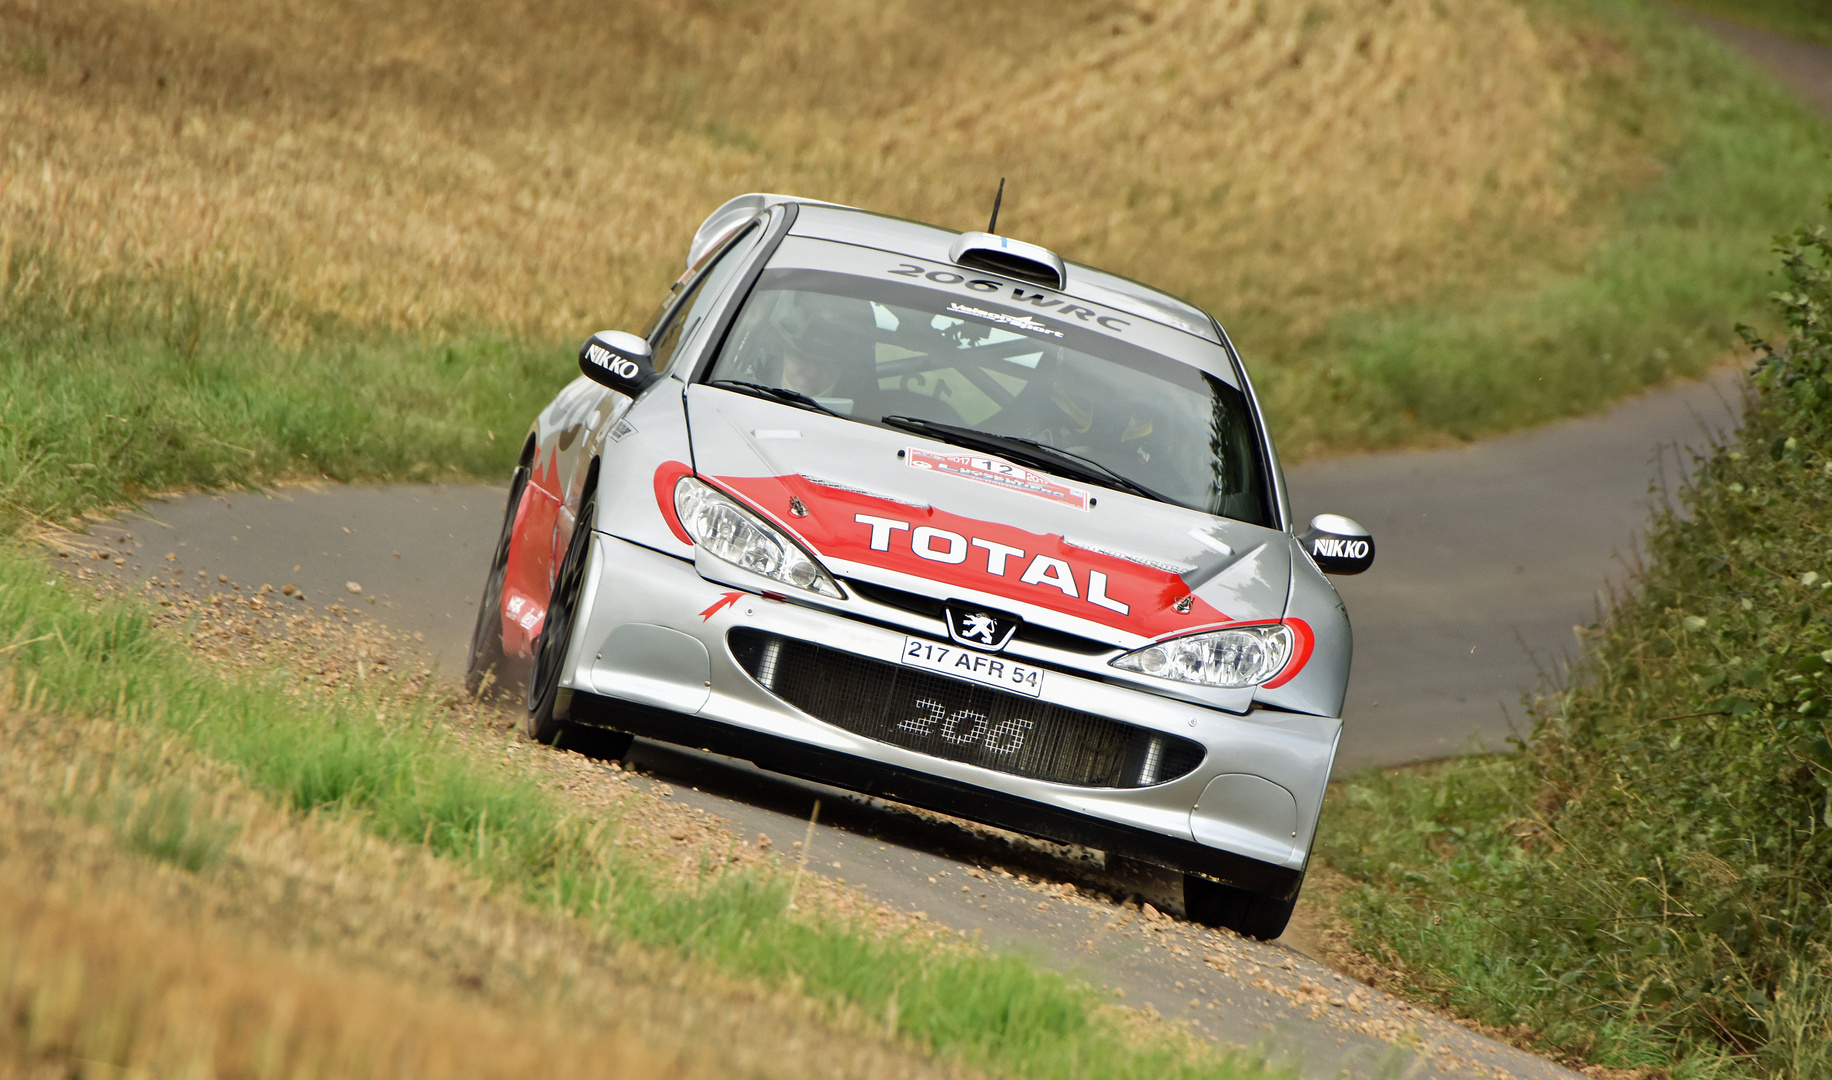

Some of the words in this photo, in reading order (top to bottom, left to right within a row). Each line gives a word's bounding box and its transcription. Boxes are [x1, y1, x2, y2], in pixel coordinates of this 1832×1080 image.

[887, 263, 1003, 293] 206
[1011, 287, 1131, 332] WRC
[584, 343, 639, 379] NIKKO
[982, 460, 1013, 476] 12
[854, 513, 1130, 615] TOTAL
[1313, 538, 1369, 559] NIKKO
[908, 641, 950, 663] 217
[955, 653, 1005, 679] AFR
[1011, 667, 1038, 688] 54
[897, 698, 1034, 754] 206
